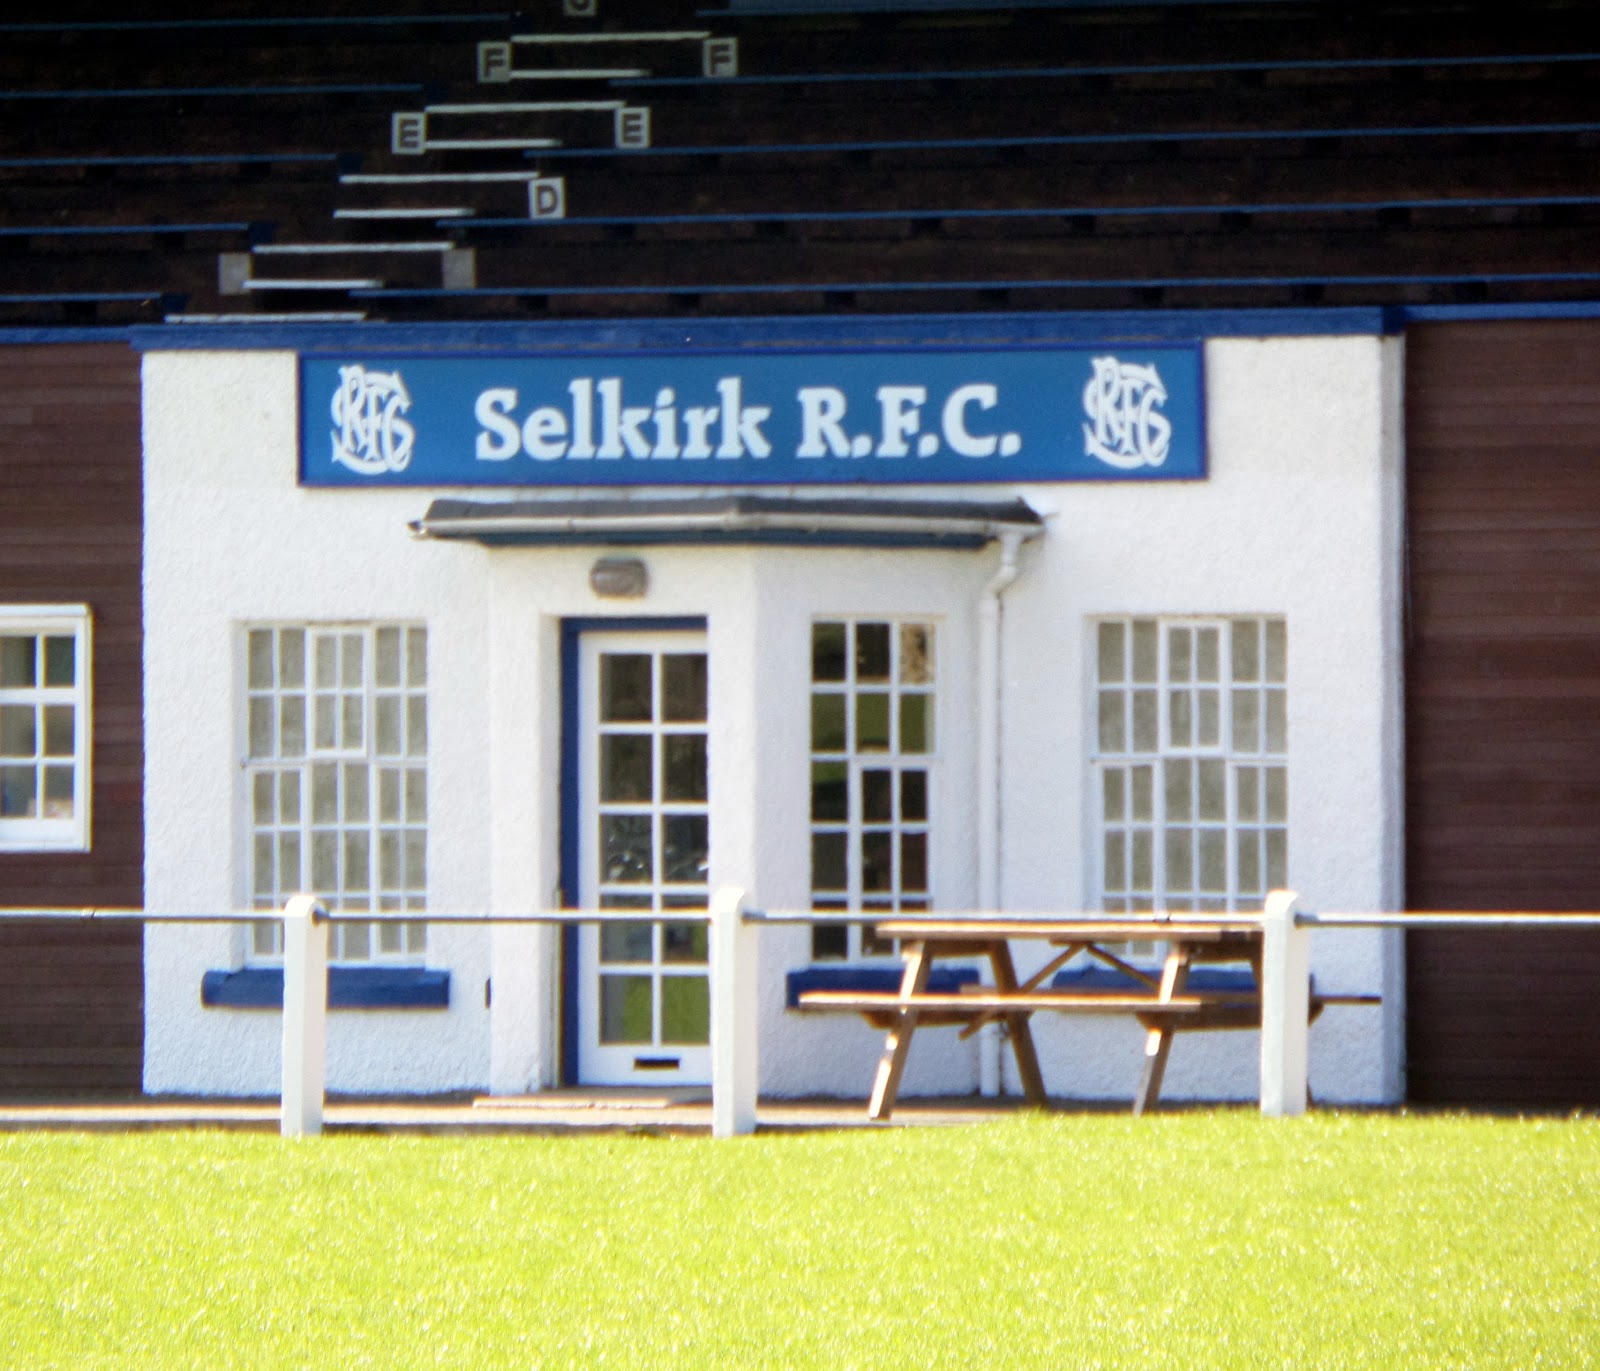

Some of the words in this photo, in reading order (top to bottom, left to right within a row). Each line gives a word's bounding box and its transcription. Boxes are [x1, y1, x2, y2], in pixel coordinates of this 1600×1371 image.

[482, 47, 506, 78] F
[709, 43, 731, 76] F
[399, 117, 421, 149] E
[622, 112, 643, 144] E
[534, 184, 558, 216] D
[474, 376, 771, 461] Selkirk
[795, 383, 1022, 459] R.F.C.
